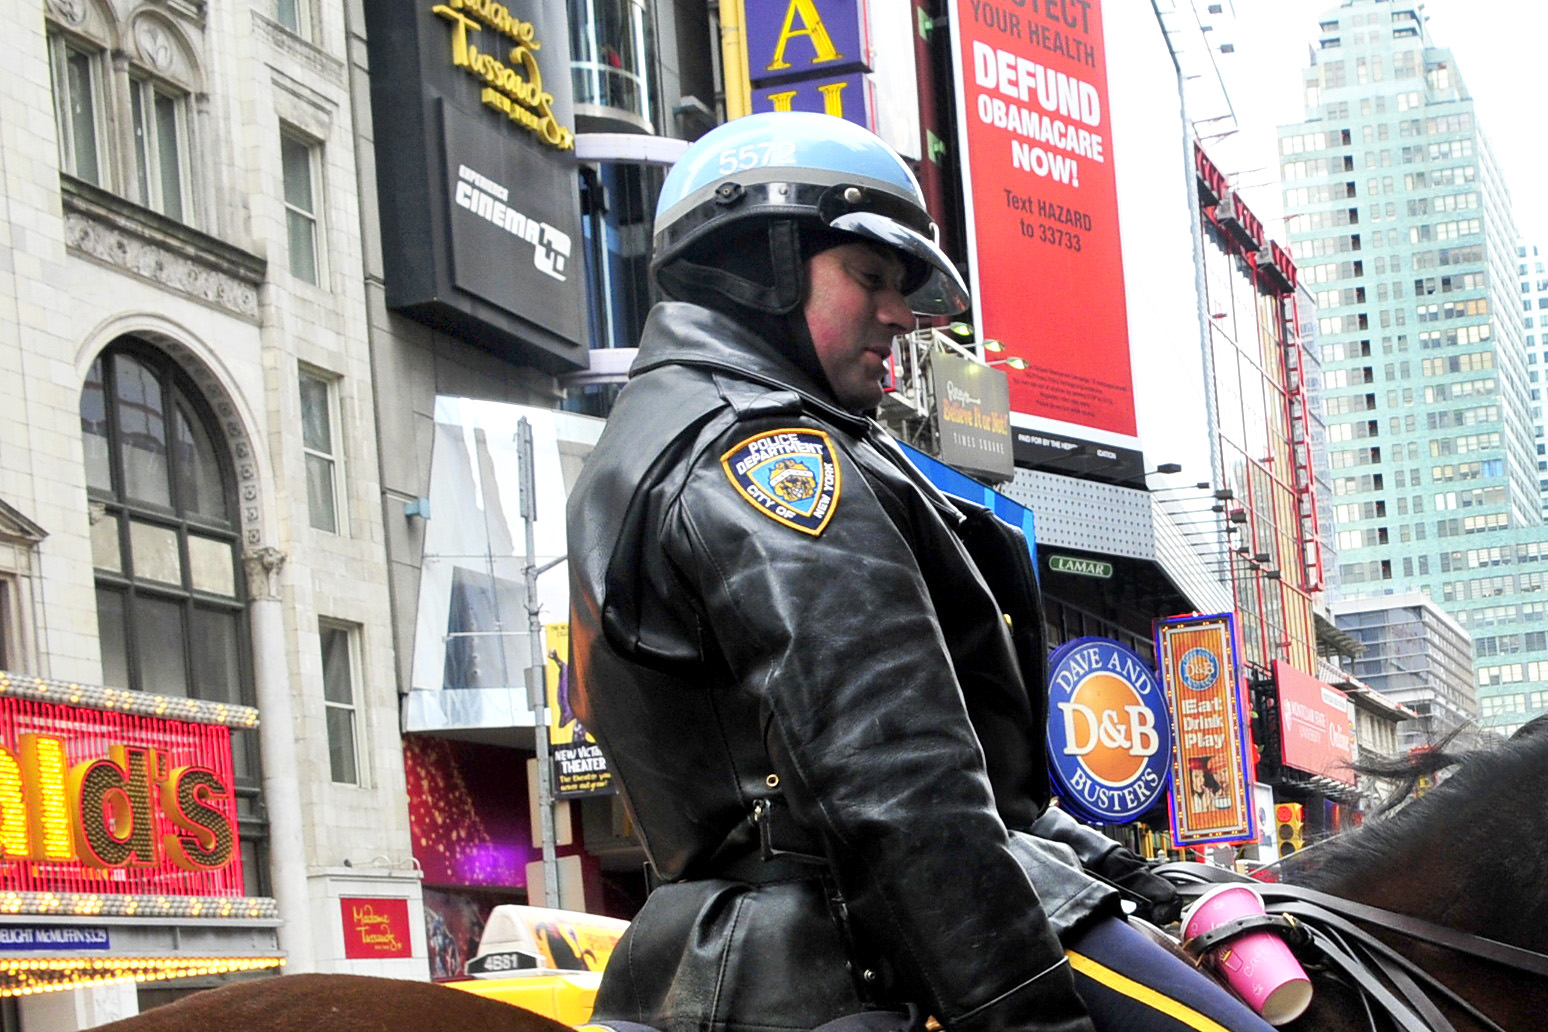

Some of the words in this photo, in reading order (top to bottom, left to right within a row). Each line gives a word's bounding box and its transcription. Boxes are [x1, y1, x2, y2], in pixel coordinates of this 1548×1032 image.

[970, 0, 1022, 39] YOUR
[1027, 19, 1096, 68] HEALTH
[432, 4, 563, 146] Tussauds
[972, 39, 1102, 127] DEFUND
[977, 93, 1104, 163] OBAMACARE
[719, 142, 797, 175] 5572
[1011, 139, 1079, 187] NOW!
[456, 180, 541, 247] CINEMA
[1003, 188, 1034, 214] Text
[1037, 197, 1092, 232] HAZARD
[1019, 218, 1035, 238] to
[1039, 222, 1082, 252] 33733
[735, 440, 824, 475] DEPARTMENT
[747, 433, 800, 456] POLICE
[953, 432, 976, 448] TIMES
[746, 484, 776, 508] CITY
[775, 505, 797, 519] OF
[812, 493, 831, 519] NEW
[823, 462, 835, 492] YORK
[1058, 558, 1104, 575] LAMAR
[1056, 647, 1102, 694] DAVE
[1108, 651, 1152, 695] AND
[1182, 696, 1223, 714] Eat
[1183, 713, 1224, 731] Drink
[1057, 702, 1160, 757] D&B
[1184, 731, 1226, 749] Play
[554, 748, 577, 761] NEW
[561, 756, 607, 774] THEATER
[1070, 767, 1159, 811] BUSTER'S
[352, 904, 391, 926] Madame
